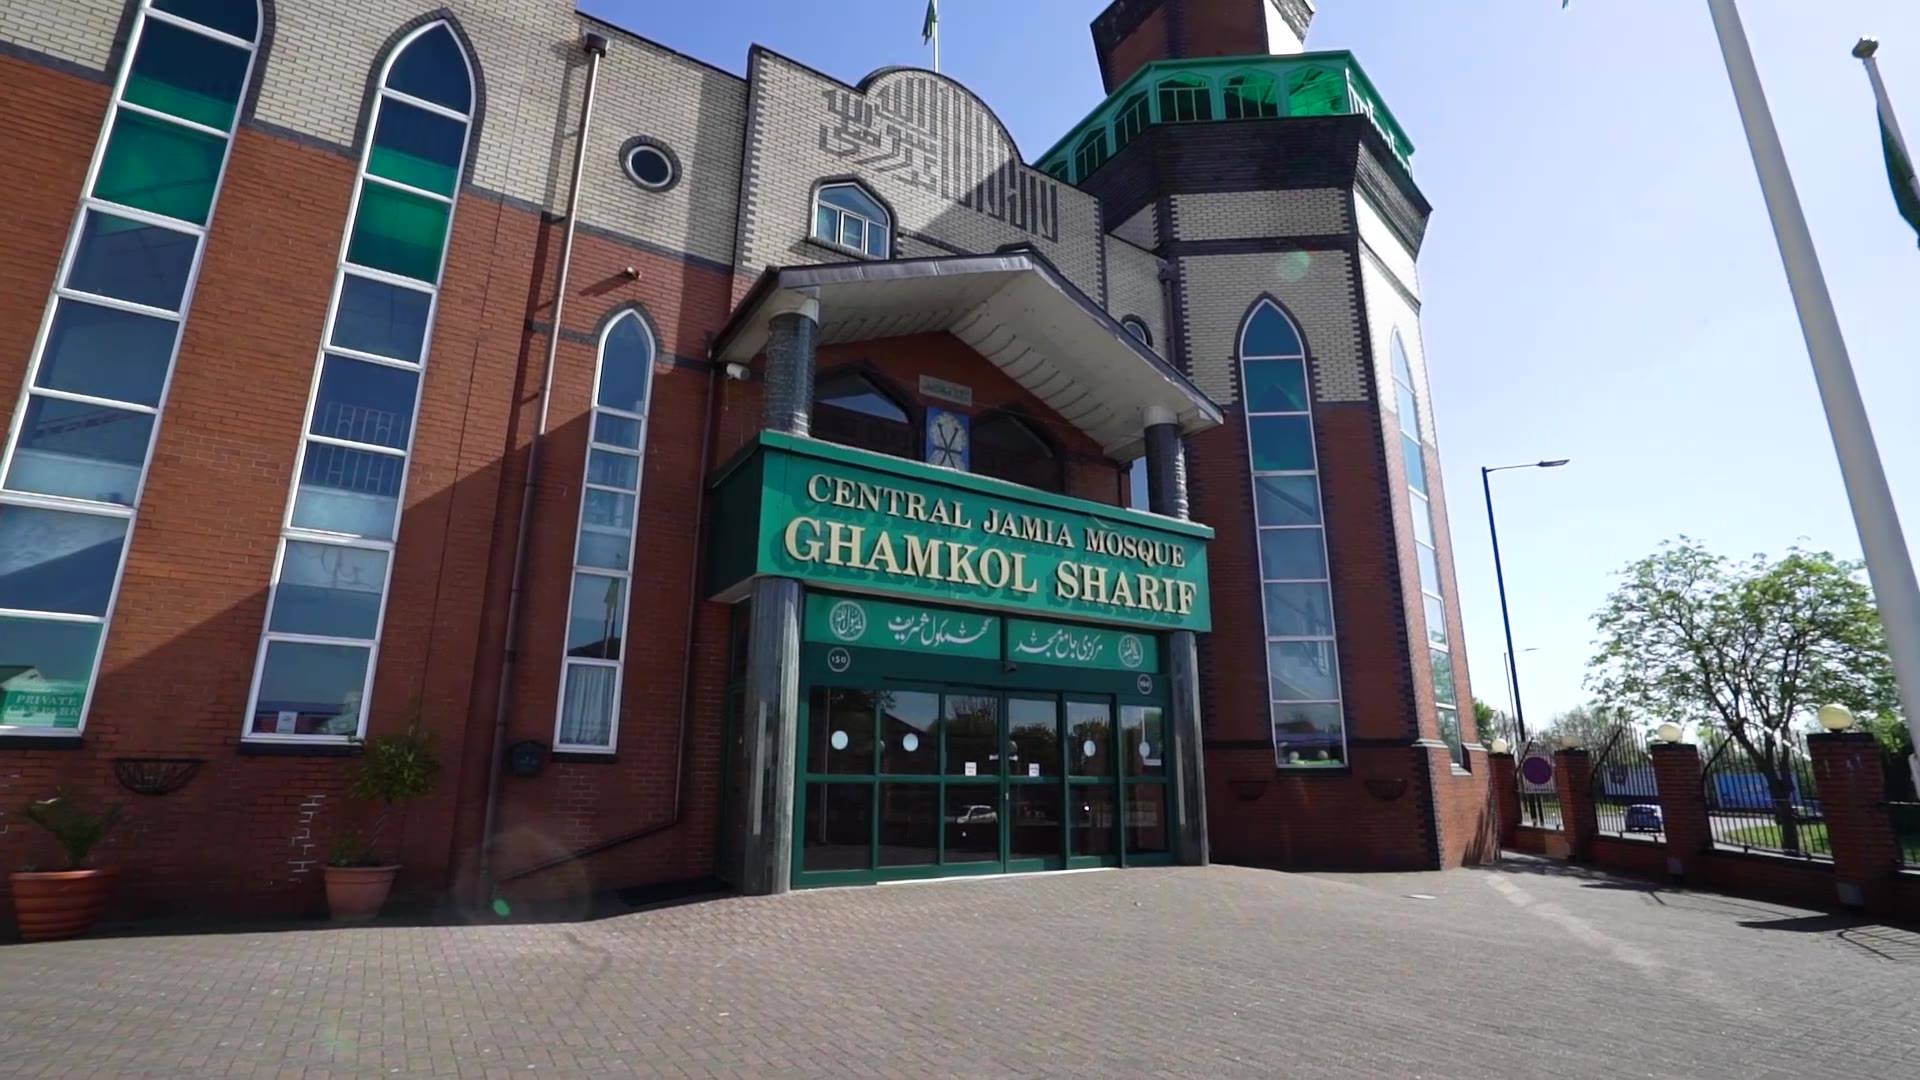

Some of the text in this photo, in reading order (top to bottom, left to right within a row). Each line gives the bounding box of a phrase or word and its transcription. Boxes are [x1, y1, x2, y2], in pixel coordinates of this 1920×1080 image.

[784, 516, 1197, 615] GHAMKOL SHARIF
[808, 474, 1185, 568] CENTRAL JAMIA MOSQUE
[15, 694, 78, 706] PRIVATE
